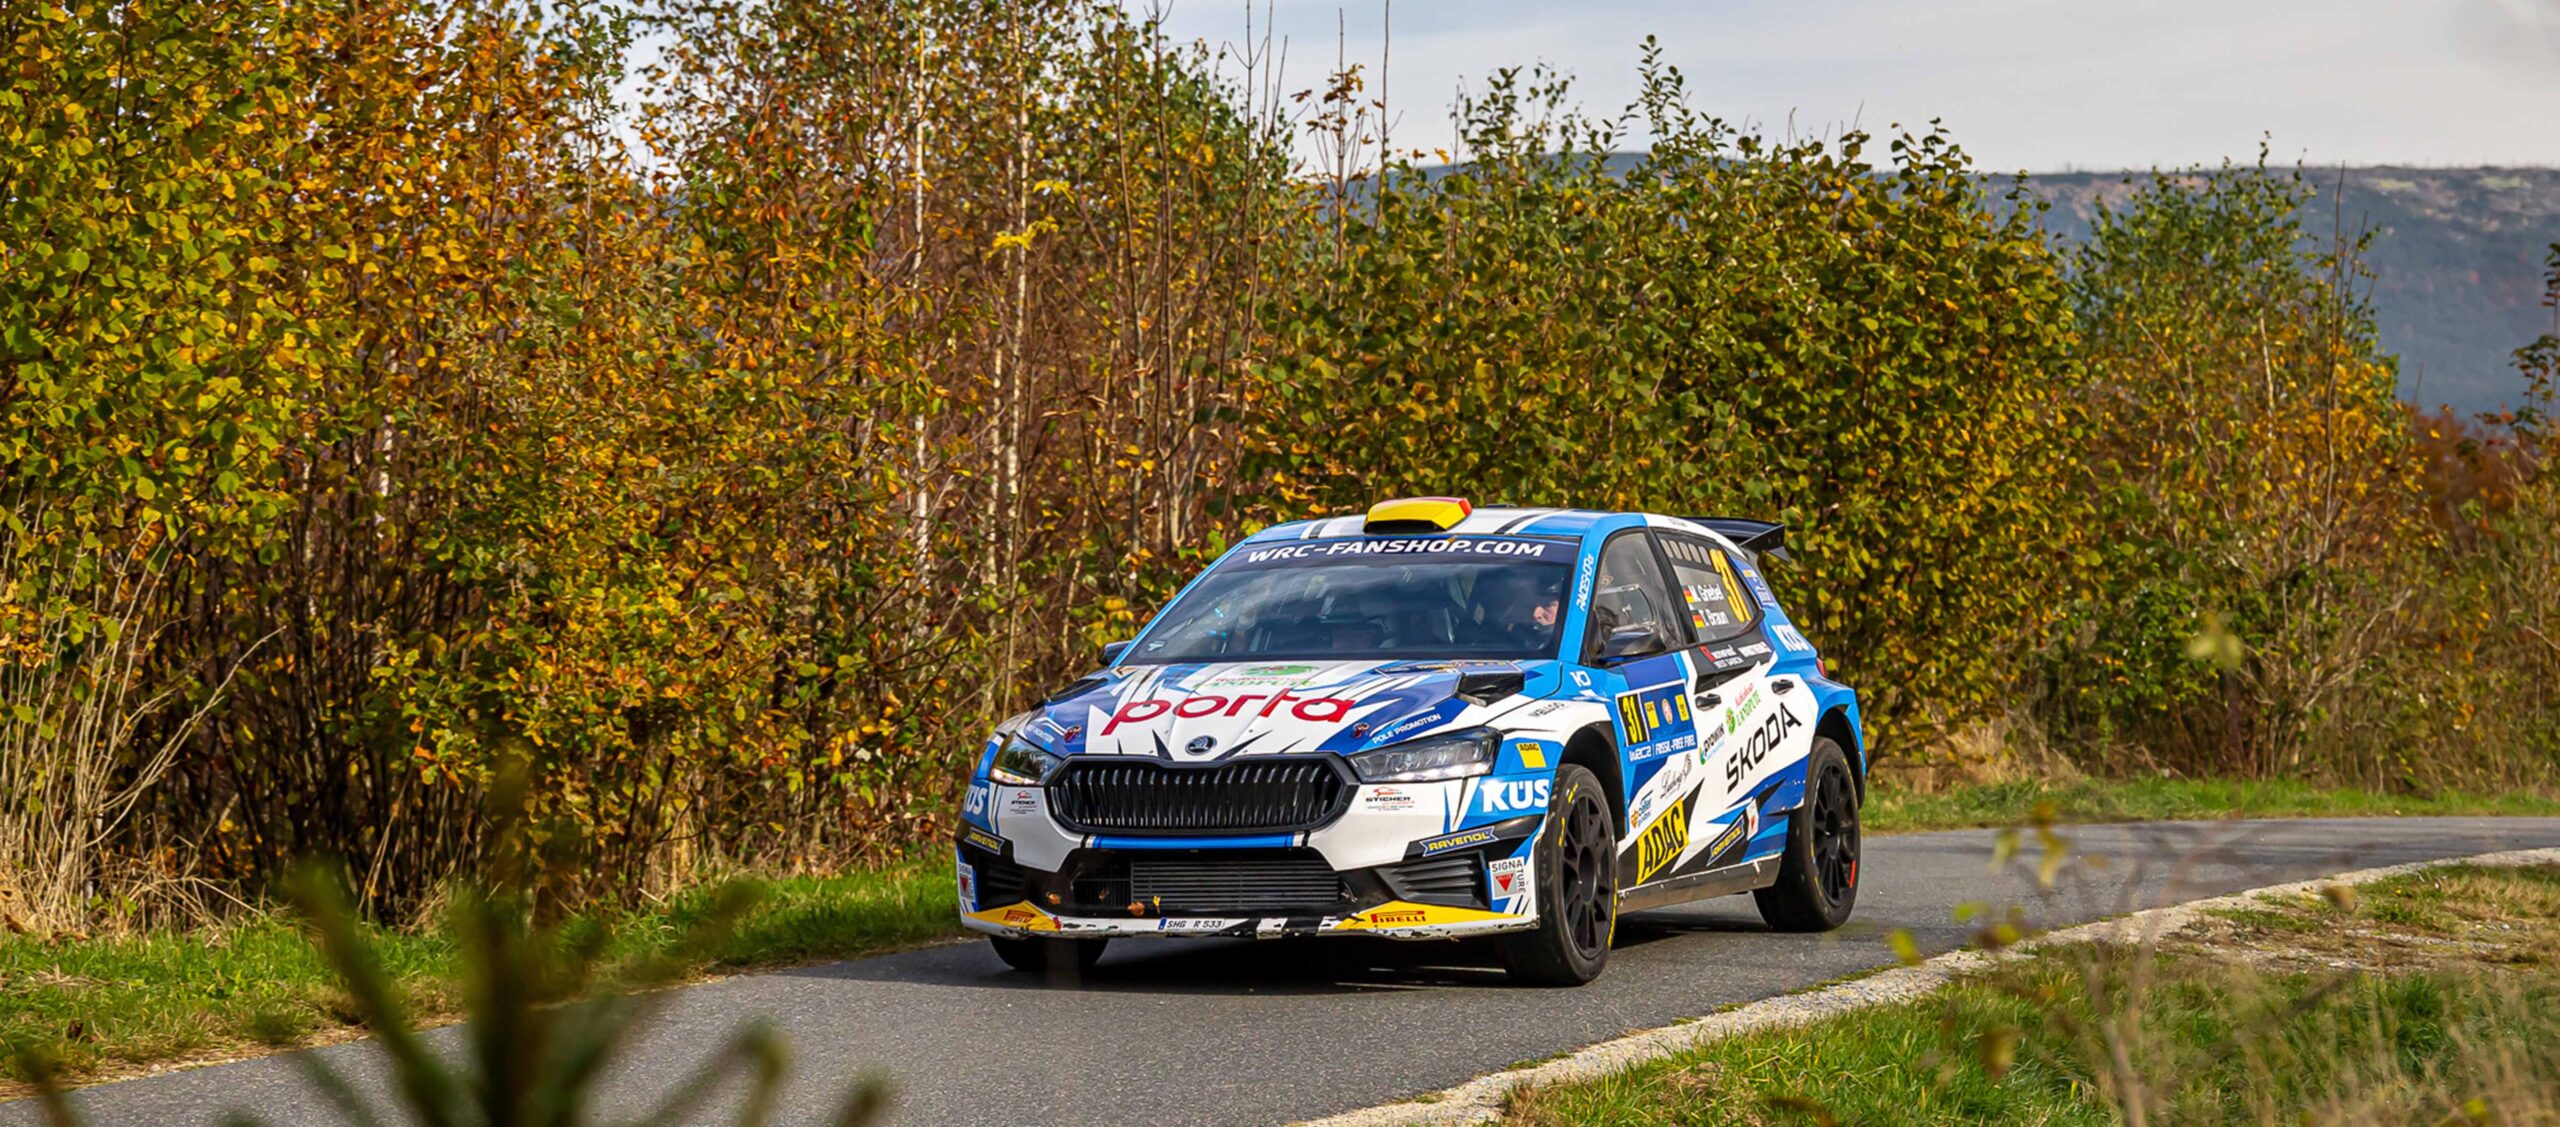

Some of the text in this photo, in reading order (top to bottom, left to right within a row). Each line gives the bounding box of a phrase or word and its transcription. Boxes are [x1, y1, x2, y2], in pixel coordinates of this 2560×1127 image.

[1248, 538, 1545, 563] WRC-FANSHOP.COM
[1698, 583, 1725, 601] Griebel
[1709, 548, 1752, 623] 31
[1705, 609, 1730, 626] Braun
[1100, 688, 1355, 736] porta
[1622, 695, 1643, 744] 31
[1372, 713, 1442, 745] POLE PROMOTION
[1519, 743, 1540, 752] ADAC
[1480, 778, 1551, 814] KÜS
[1428, 831, 1491, 852] RAVENOL
[1641, 805, 1685, 881] ADAC
[1491, 858, 1524, 873] SIGNA
[1516, 867, 1527, 893] TURE
[1167, 920, 1223, 929] SHG R 533
[1371, 910, 1426, 923] PIRELLI
